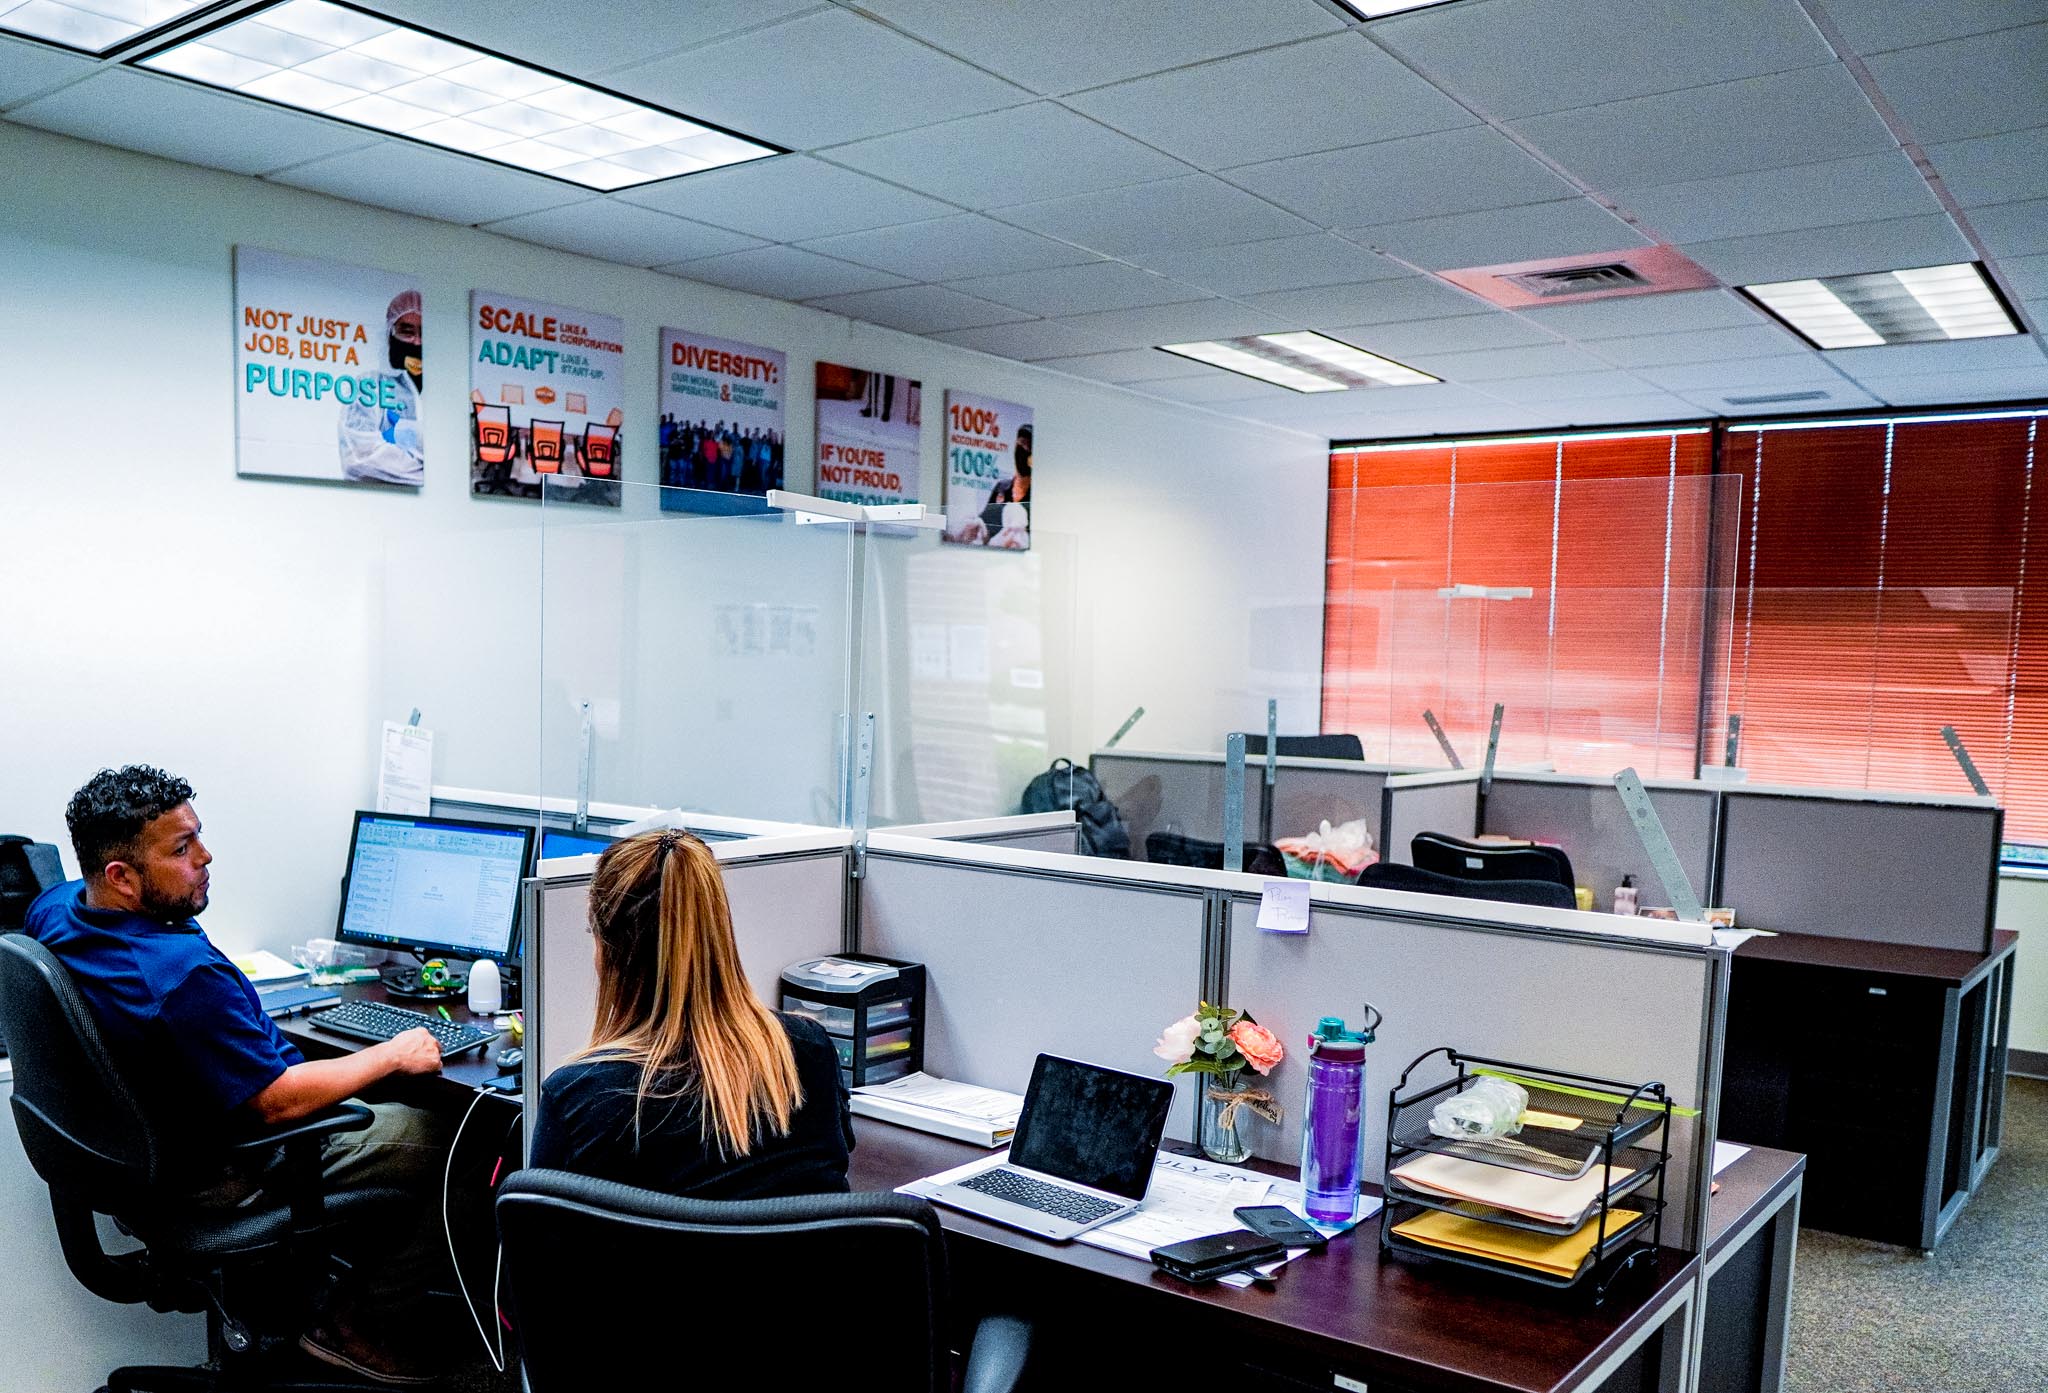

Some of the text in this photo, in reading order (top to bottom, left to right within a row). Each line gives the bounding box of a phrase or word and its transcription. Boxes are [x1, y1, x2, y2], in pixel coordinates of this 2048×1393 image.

[245, 306, 367, 344] NOT JUST A
[479, 304, 588, 341] SCALE LIKE A
[245, 333, 360, 366] JOB, BUT A
[478, 339, 589, 374] ADAPT LIKE A
[560, 333, 623, 354] CORPORATION
[671, 342, 778, 384] DIVERSITY:
[246, 363, 407, 411] PURPOSE.
[720, 383, 731, 402] &
[950, 404, 999, 438] 100%
[820, 444, 885, 468] IF YOU'RE
[950, 448, 999, 479] 100%
[821, 464, 903, 493] NOT PROUD,
